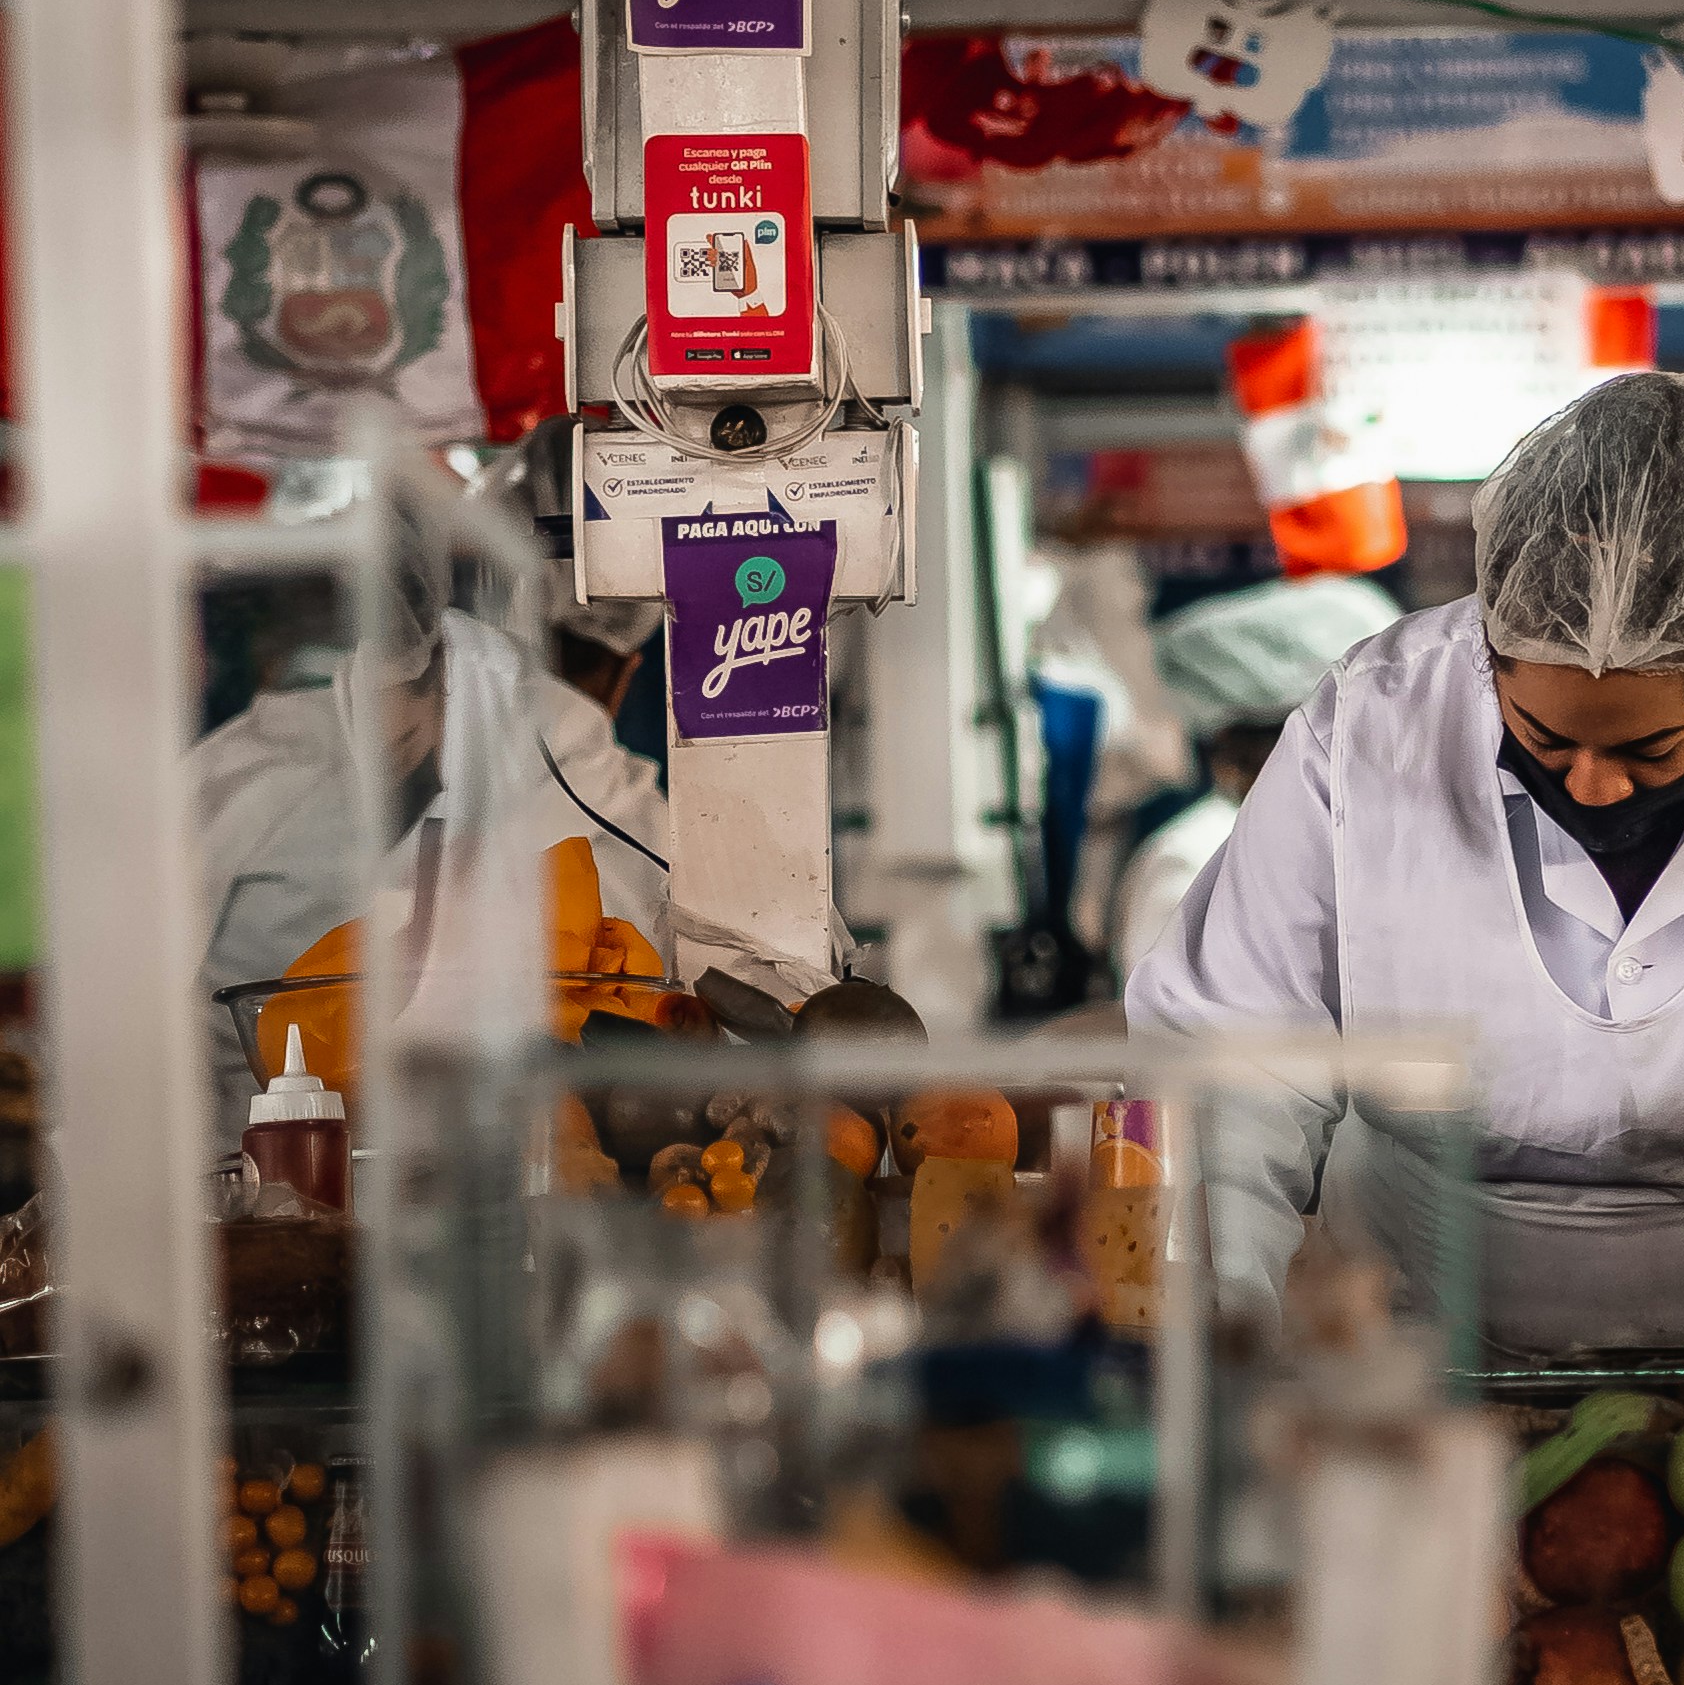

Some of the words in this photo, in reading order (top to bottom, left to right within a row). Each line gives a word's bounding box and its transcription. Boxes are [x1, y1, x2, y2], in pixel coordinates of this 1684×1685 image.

[684, 147, 730, 158] Escanea
[731, 148, 738, 159] y
[739, 148, 767, 160] paga
[679, 160, 729, 173] cualquier
[731, 160, 748, 170] QR
[750, 159, 772, 170] Plin
[709, 174, 743, 184] desde
[690, 185, 762, 209] tunki
[677, 522, 728, 540] PAGA
[702, 607, 812, 699] yape
